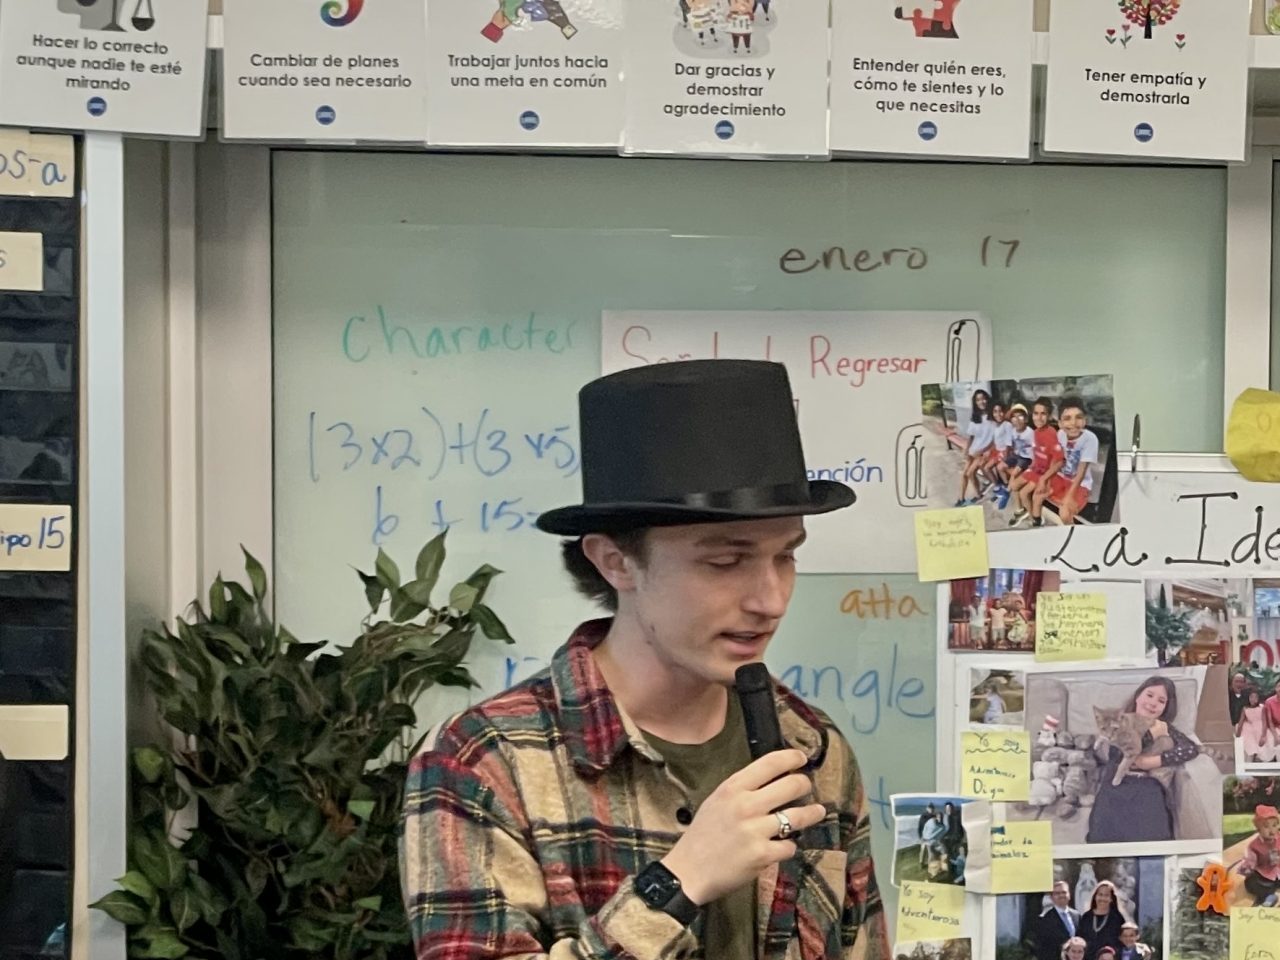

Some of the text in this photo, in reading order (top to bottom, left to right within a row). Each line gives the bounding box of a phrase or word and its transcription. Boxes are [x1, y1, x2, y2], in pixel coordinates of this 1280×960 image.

[33, 35, 168, 55] Hacer lo correcto
[17, 54, 182, 75] aunque nadie te esté
[250, 54, 399, 70] Cambiar de planes
[448, 54, 608, 70] Trabajar juntos hacia
[853, 58, 1006, 78] Entender quién eres,
[675, 63, 775, 80] Dar gracias y
[1085, 68, 1207, 89] Tener empatía y
[66, 76, 130, 91] mirando
[238, 74, 412, 87] cuando sea necesario
[451, 74, 607, 88] una meta en común
[854, 76, 1004, 97] cómo te sientes y lo
[686, 83, 763, 96] demostrar
[1100, 90, 1190, 104] demostrarla
[663, 103, 786, 117] agradecimiento
[876, 100, 981, 114] que necesitas
[779, 235, 1020, 275] enero 17
[810, 335, 927, 387] Regresar
[38, 516, 65, 549] 15
[1044, 526, 1149, 573] La
